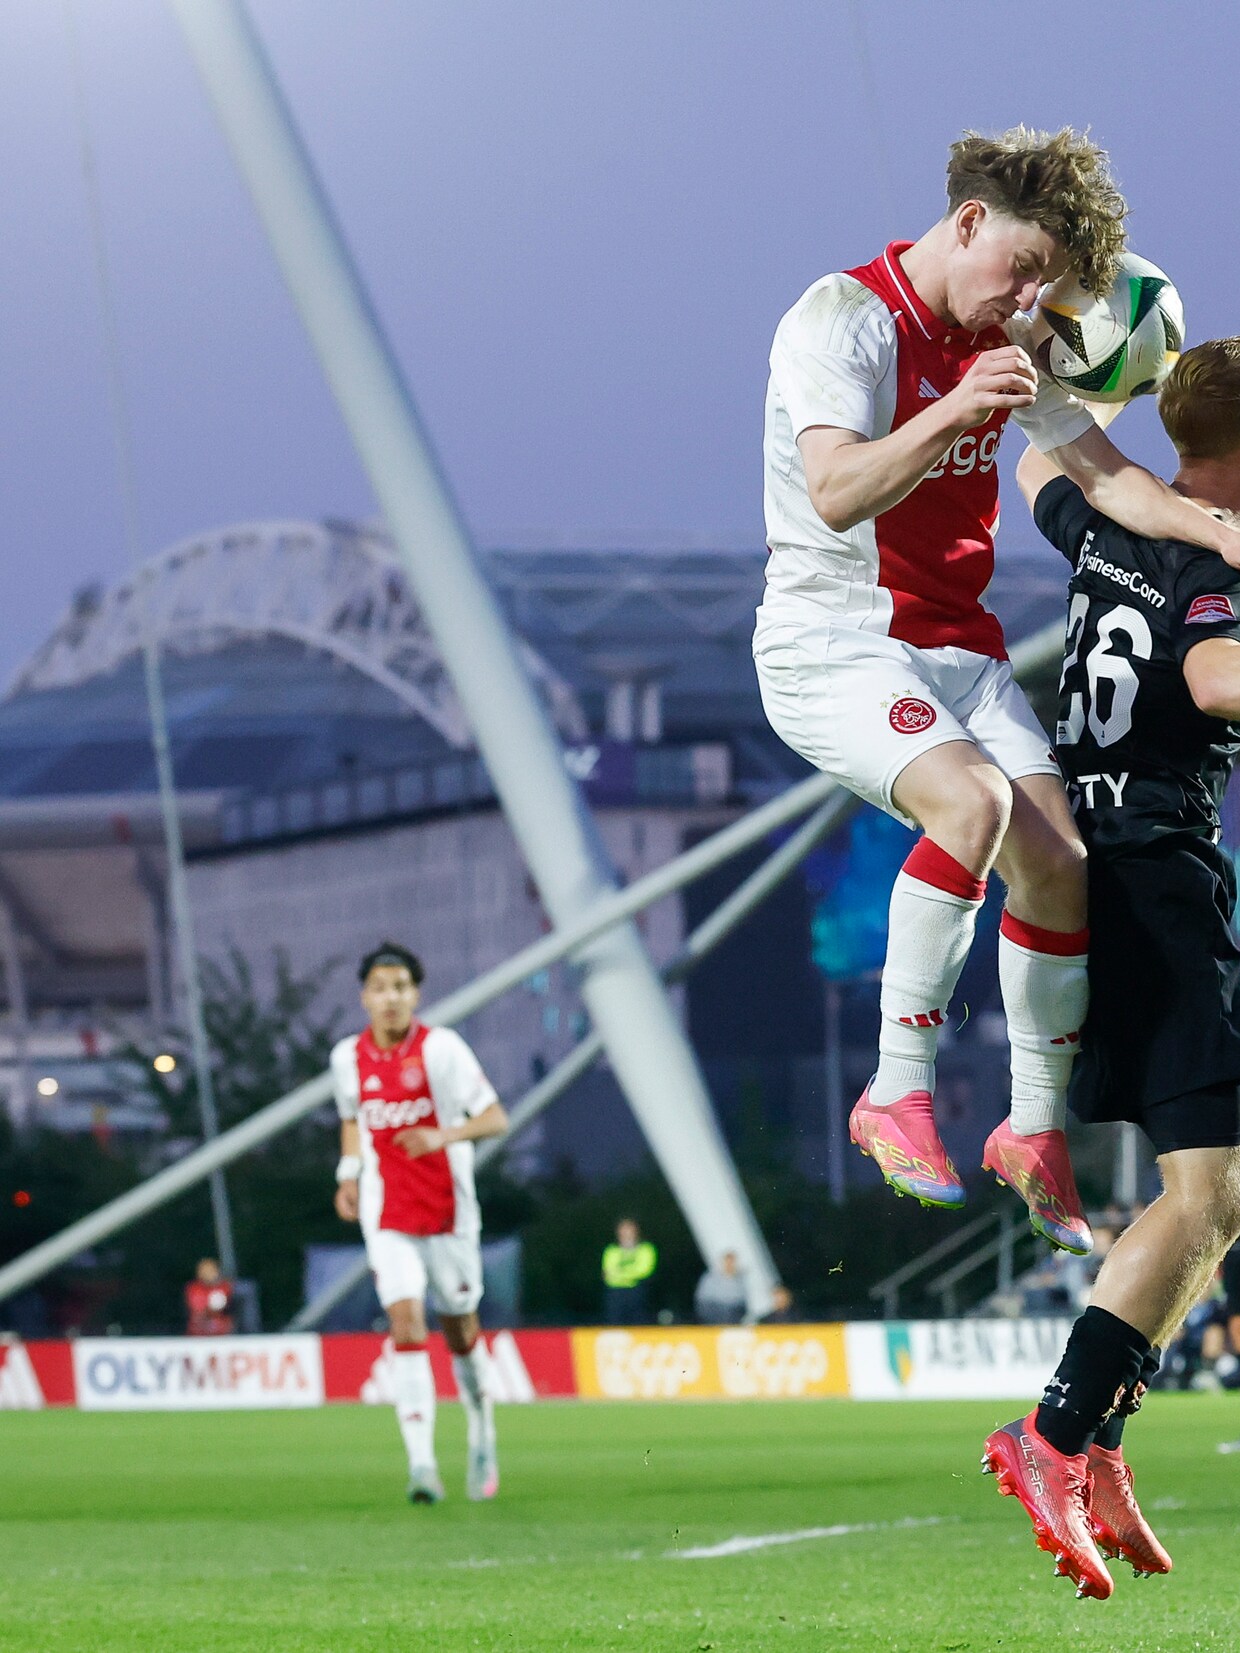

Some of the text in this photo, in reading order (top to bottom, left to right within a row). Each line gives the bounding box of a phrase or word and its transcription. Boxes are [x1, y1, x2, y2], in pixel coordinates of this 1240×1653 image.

[1080, 548, 1166, 609] sinessCom
[1071, 771, 1130, 811] TY
[87, 1352, 309, 1395] OLYMPIA
[1019, 1434, 1044, 1497] ULTRA
